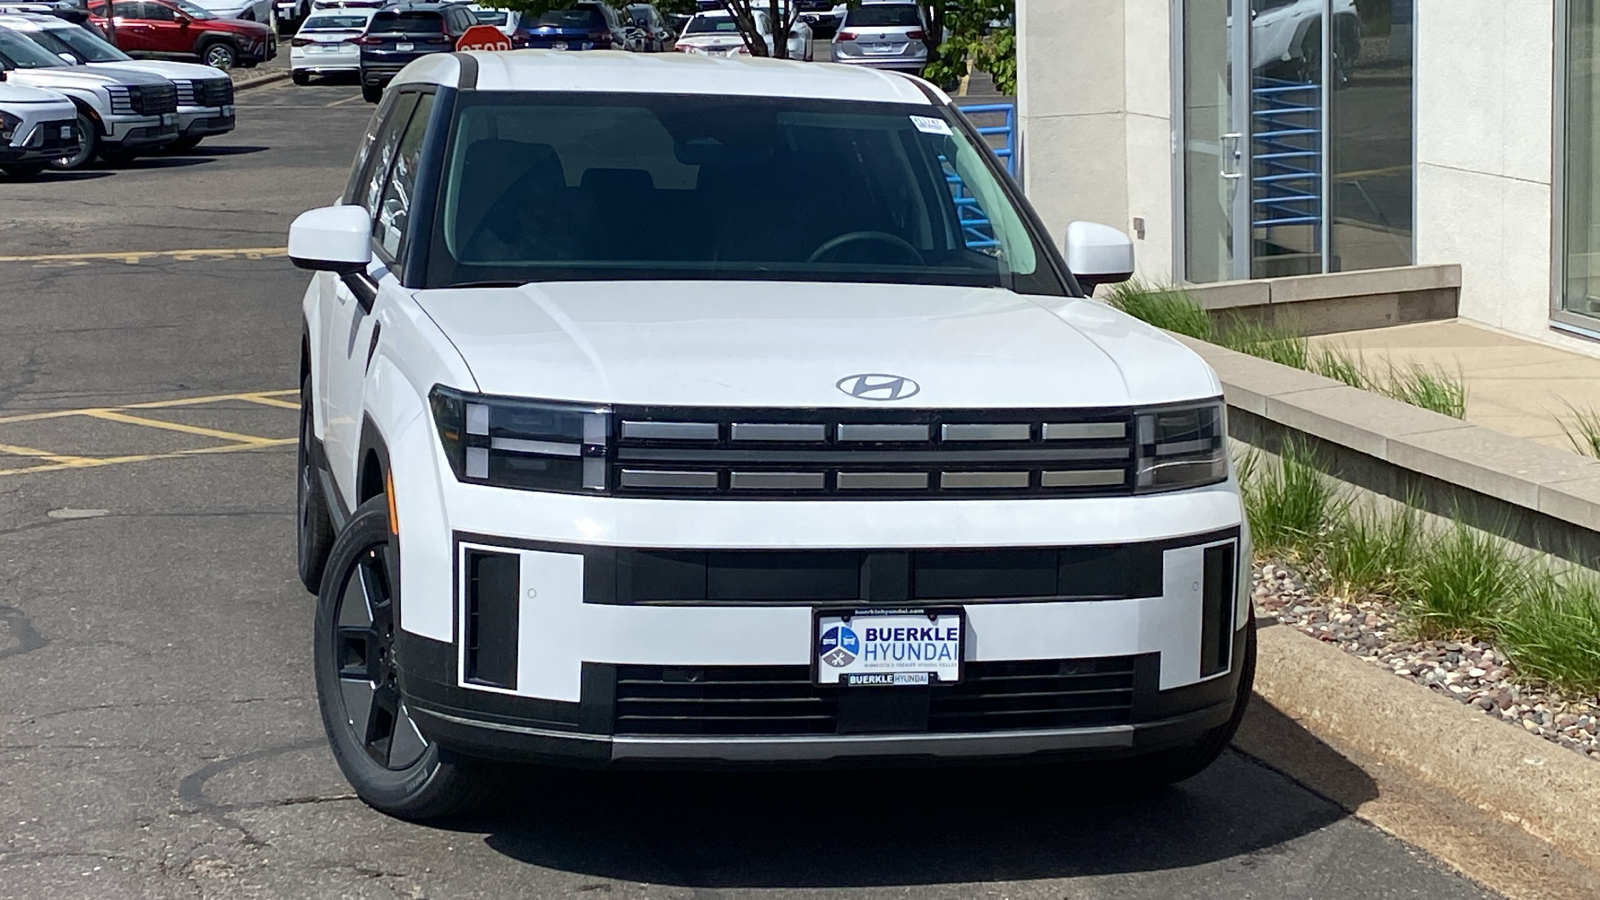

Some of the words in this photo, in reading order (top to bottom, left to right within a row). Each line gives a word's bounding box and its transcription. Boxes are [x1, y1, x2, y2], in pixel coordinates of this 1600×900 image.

[865, 627, 958, 642] BUERKLE
[864, 643, 958, 661] HYUNDAI
[849, 674, 893, 684] BUERKLE
[894, 674, 927, 683] HYUNDAI
